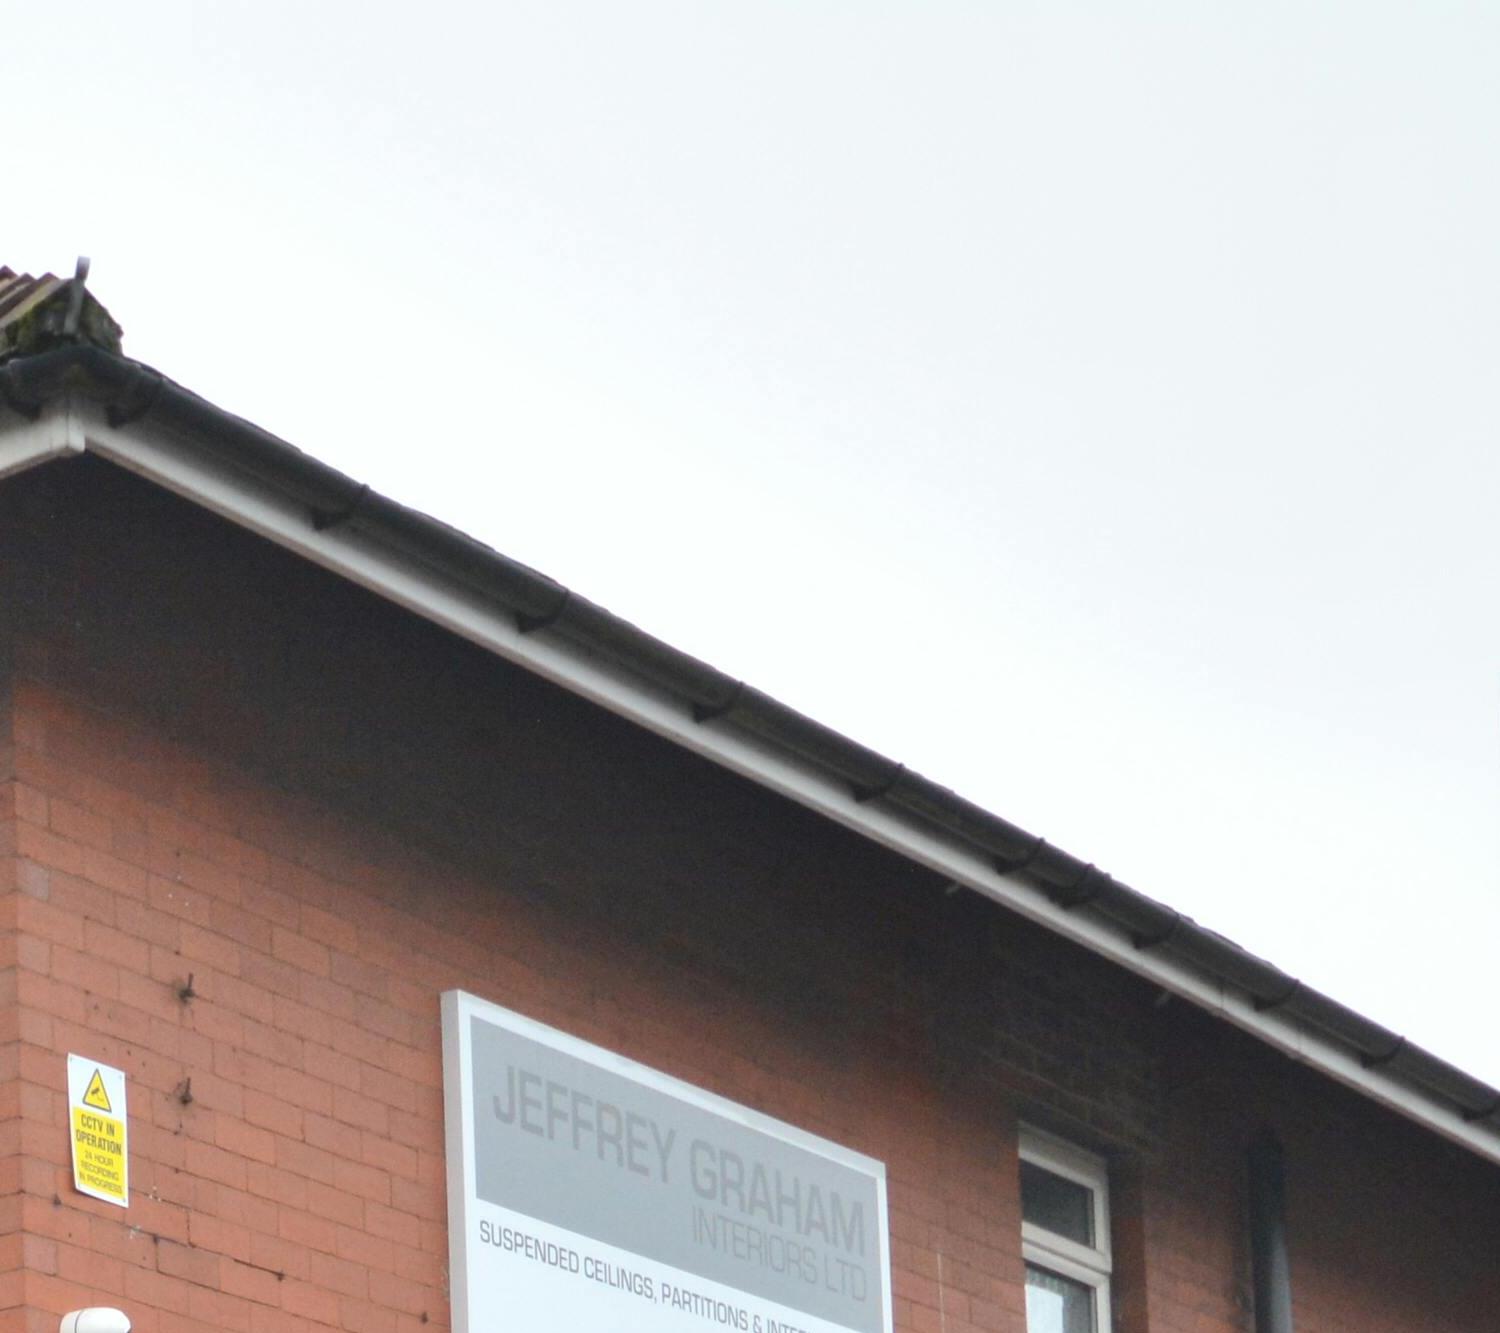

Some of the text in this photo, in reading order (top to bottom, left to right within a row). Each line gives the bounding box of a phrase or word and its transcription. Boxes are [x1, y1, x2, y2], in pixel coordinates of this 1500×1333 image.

[81, 1113, 115, 1136] CCTV IN
[75, 1129, 122, 1155] OPERATION
[81, 1160, 119, 1181] RECORDING
[94, 1152, 113, 1167] HOUR
[493, 1065, 866, 1257] JEFFREY GRAHAM
[86, 1174, 123, 1194] PROGRESS
[692, 1205, 867, 1303] INTERIORS LTD
[479, 1219, 580, 1274] SUSPENDED
[584, 1256, 658, 1304] CEILINGS,
[661, 1282, 749, 1332] PARTITIONS
